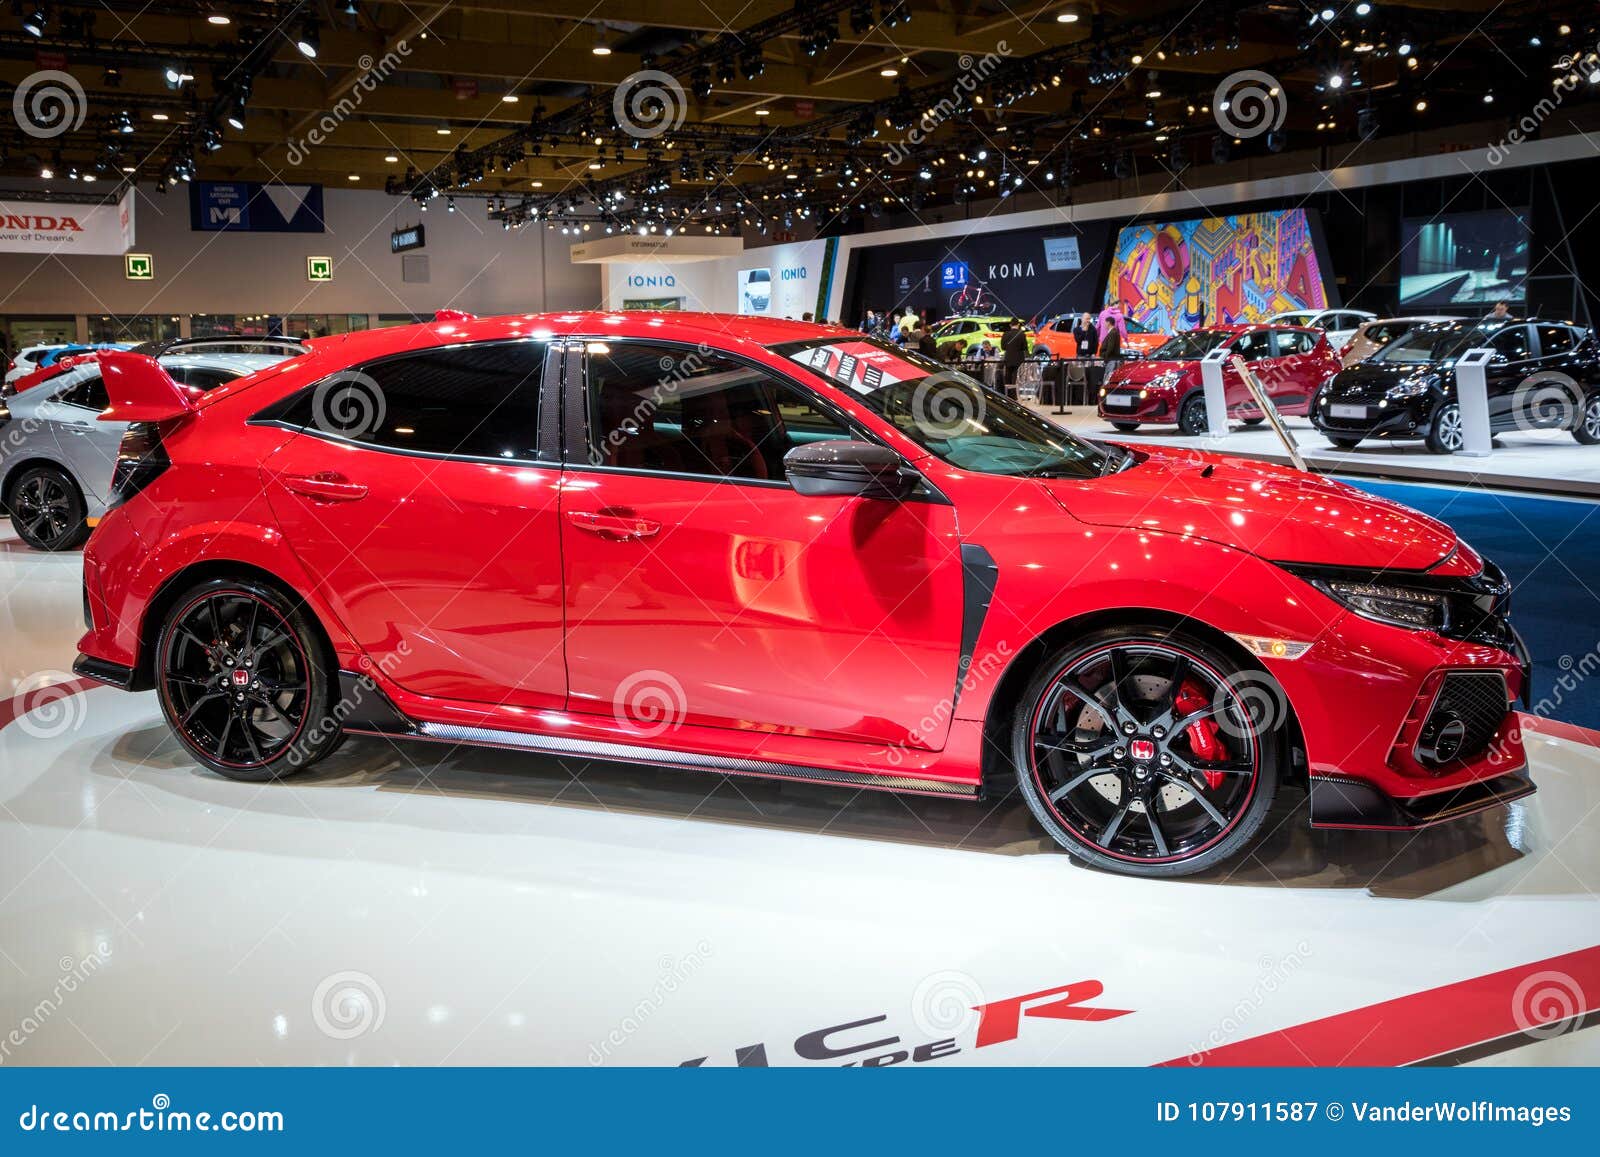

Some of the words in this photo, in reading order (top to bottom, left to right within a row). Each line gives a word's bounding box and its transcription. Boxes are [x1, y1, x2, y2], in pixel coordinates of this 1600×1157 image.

[35, 233, 74, 242] Dreams
[781, 267, 807, 280] IONIQ
[628, 275, 675, 287] IONIQ
